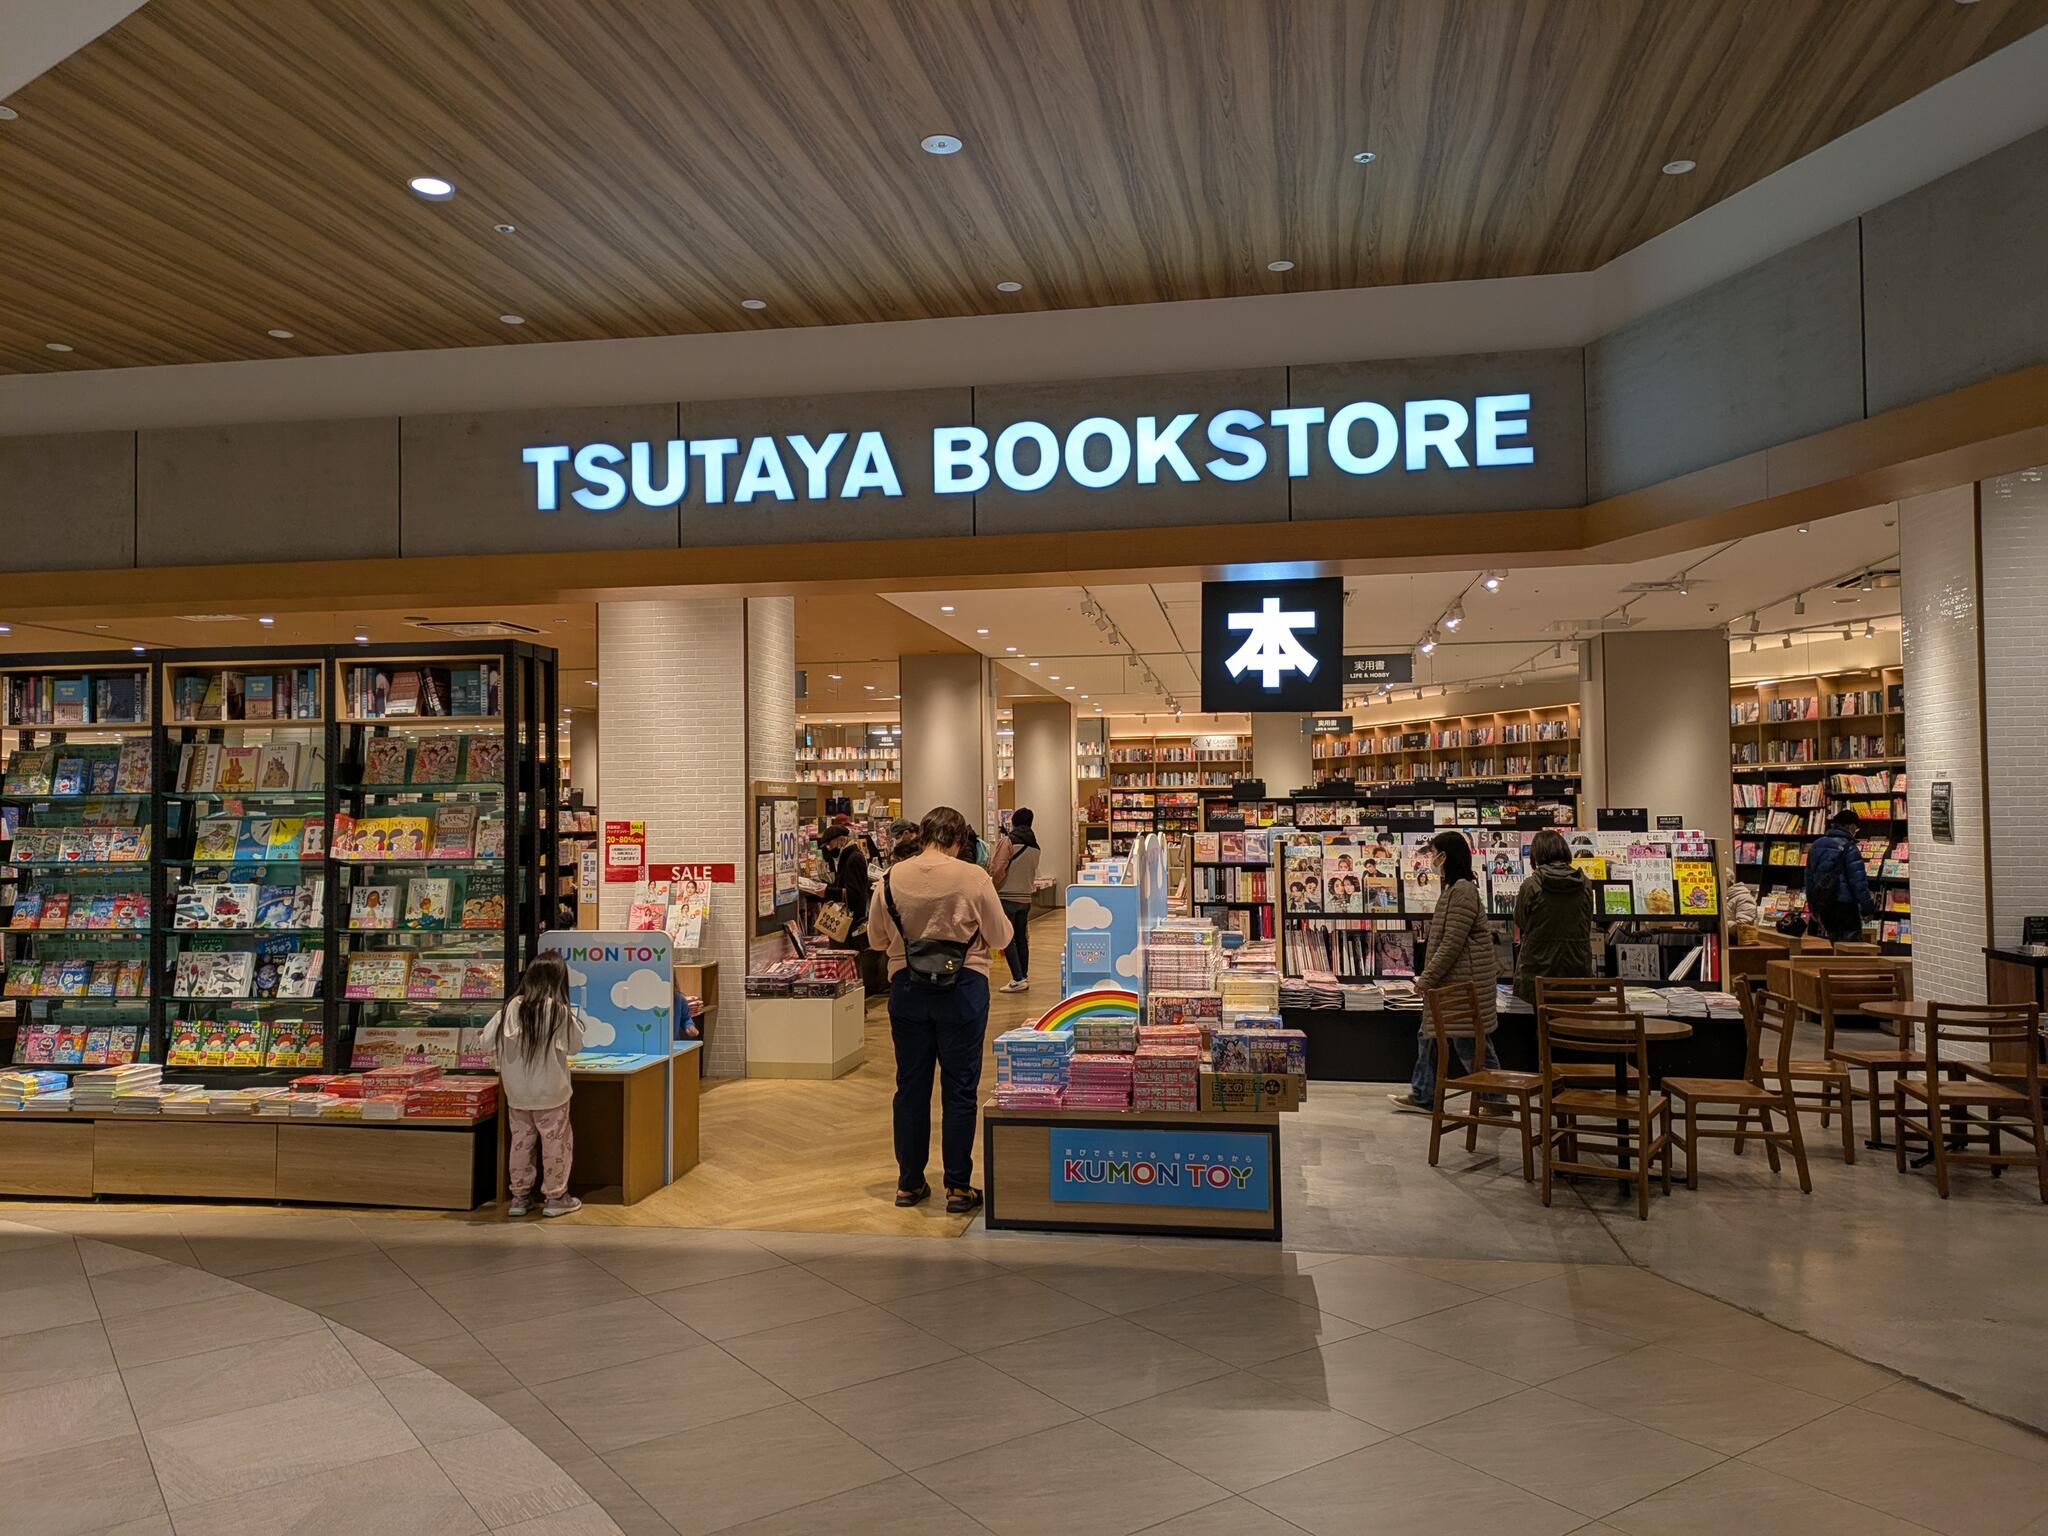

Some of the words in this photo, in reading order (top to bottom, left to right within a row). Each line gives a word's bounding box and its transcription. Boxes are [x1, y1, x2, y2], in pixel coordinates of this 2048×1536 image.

[522, 431, 902, 511] TSUTAYA
[933, 393, 1534, 494] BOOKSTORE
[1226, 597, 1319, 689] 本
[1354, 660, 1385, 670] 実用書
[426, 676, 441, 712] DREAMS
[780, 832, 795, 864] 100
[671, 866, 711, 880] SALE
[624, 947, 666, 962] TOY
[1251, 1041, 1288, 1051] 日本の歴史
[1173, 1152, 1254, 1163] 学びのちから
[1064, 1159, 1180, 1187] KUMON
[1185, 1163, 1254, 1190] TOY
